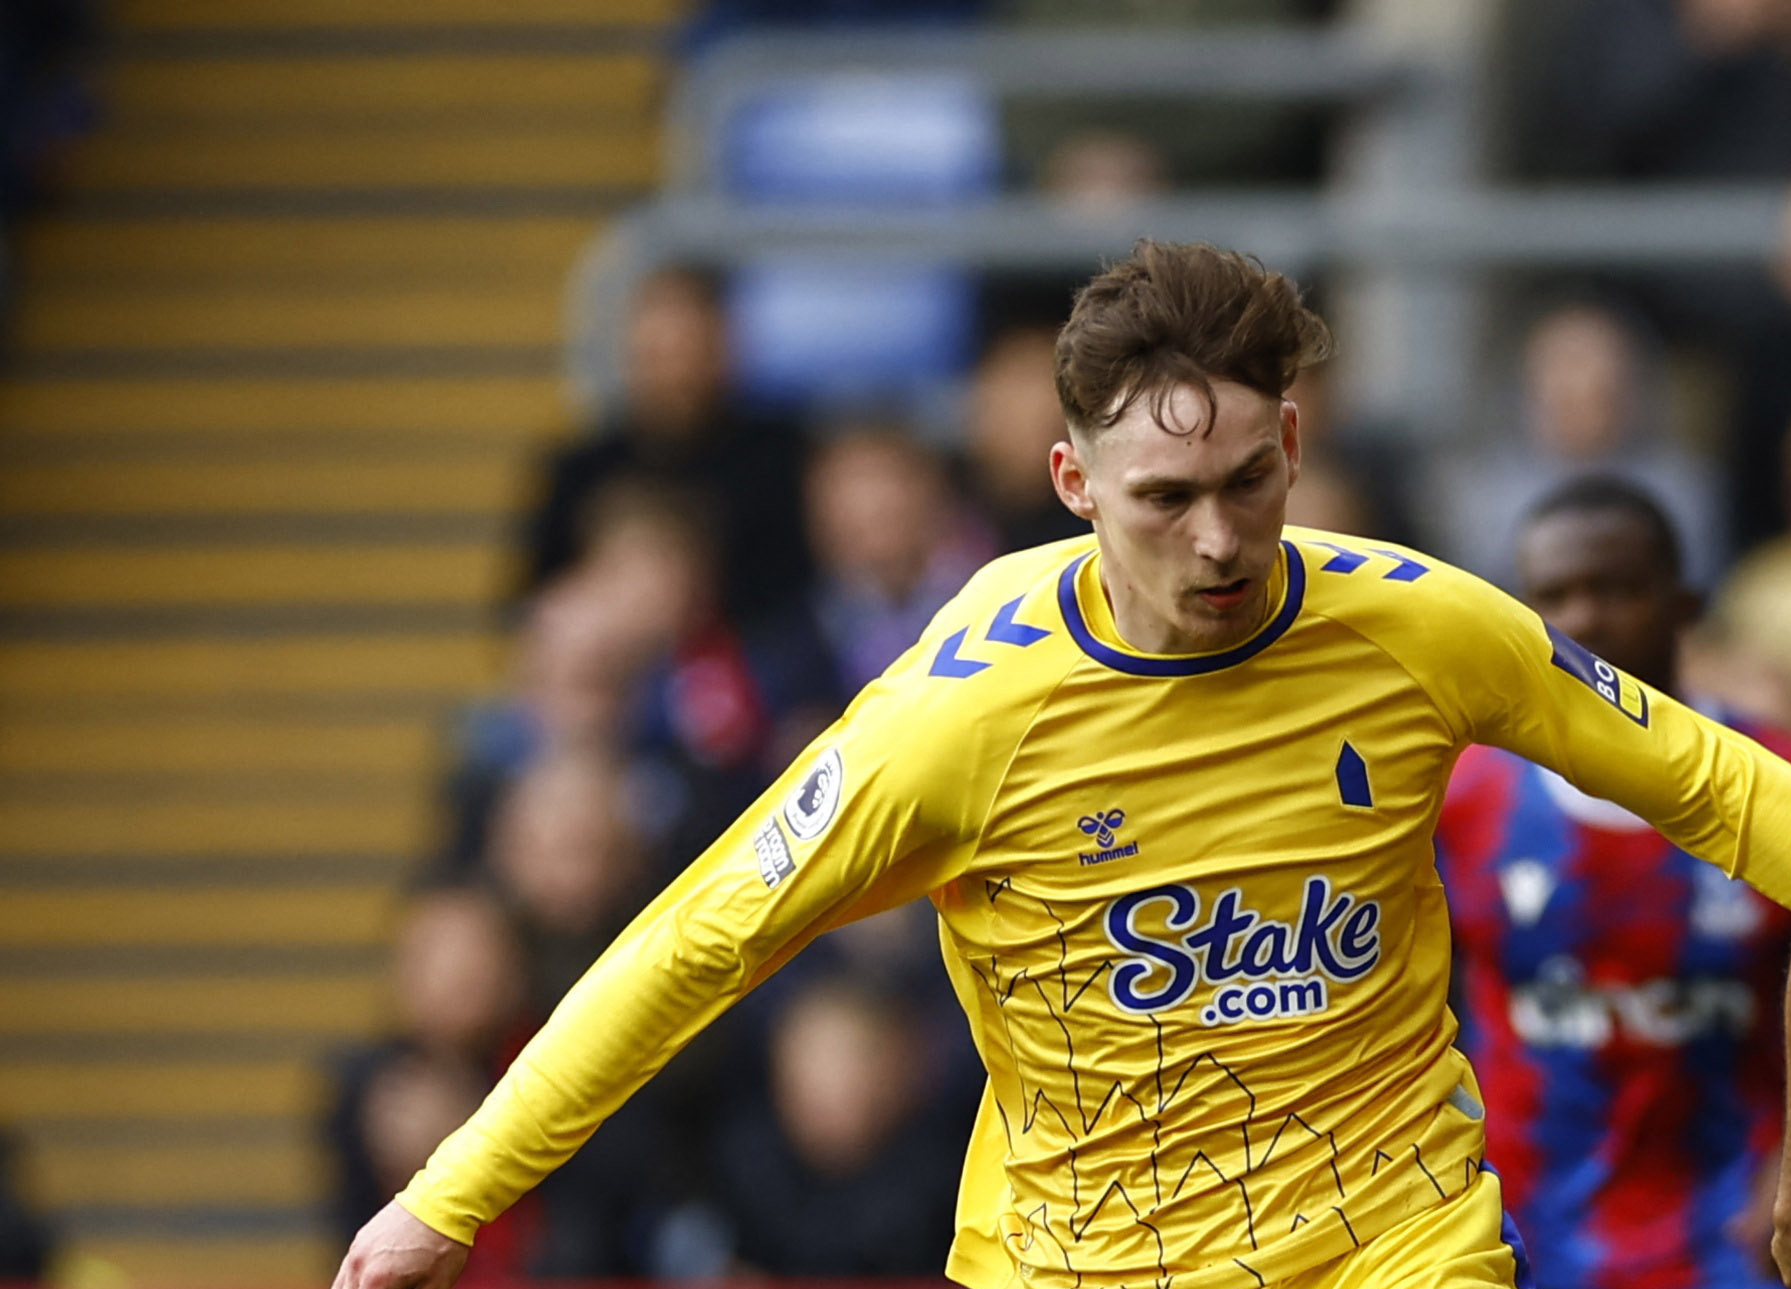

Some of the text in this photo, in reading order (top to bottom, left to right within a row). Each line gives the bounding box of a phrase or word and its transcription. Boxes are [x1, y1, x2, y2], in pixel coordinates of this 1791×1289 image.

[1079, 841, 1138, 866] hummel
[1106, 877, 1381, 1012] Stake
[1204, 979, 1324, 1022] .com
